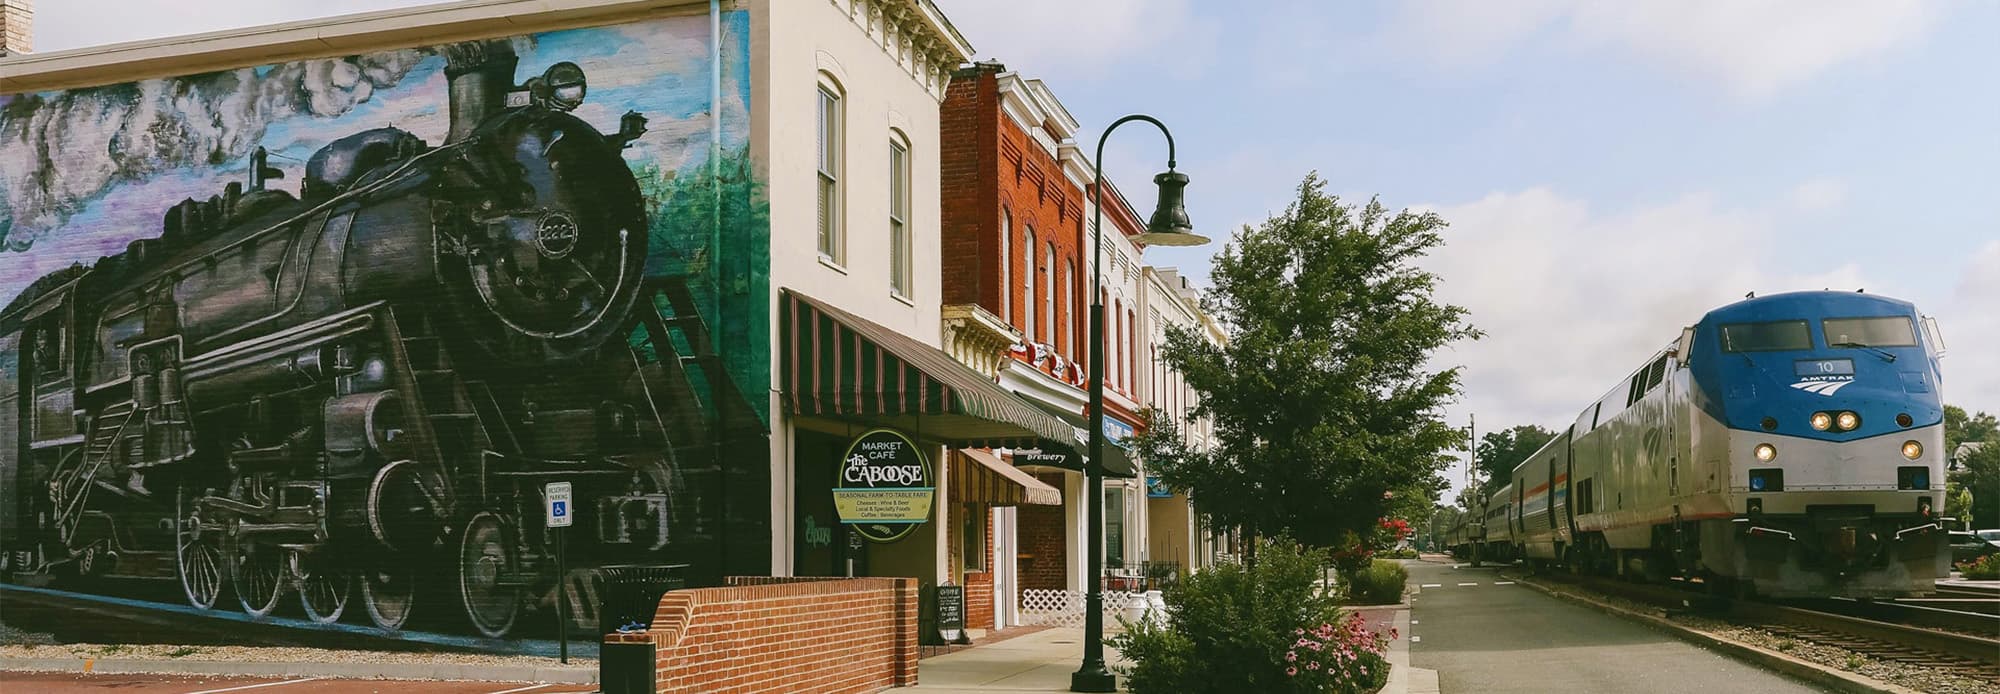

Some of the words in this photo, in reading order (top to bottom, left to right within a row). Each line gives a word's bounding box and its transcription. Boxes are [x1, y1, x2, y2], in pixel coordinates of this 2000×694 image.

[1816, 361, 1834, 373] 10
[862, 441, 903, 451] MARKET
[1027, 453, 1066, 464] brewery
[844, 465, 923, 488] CABOOSE
